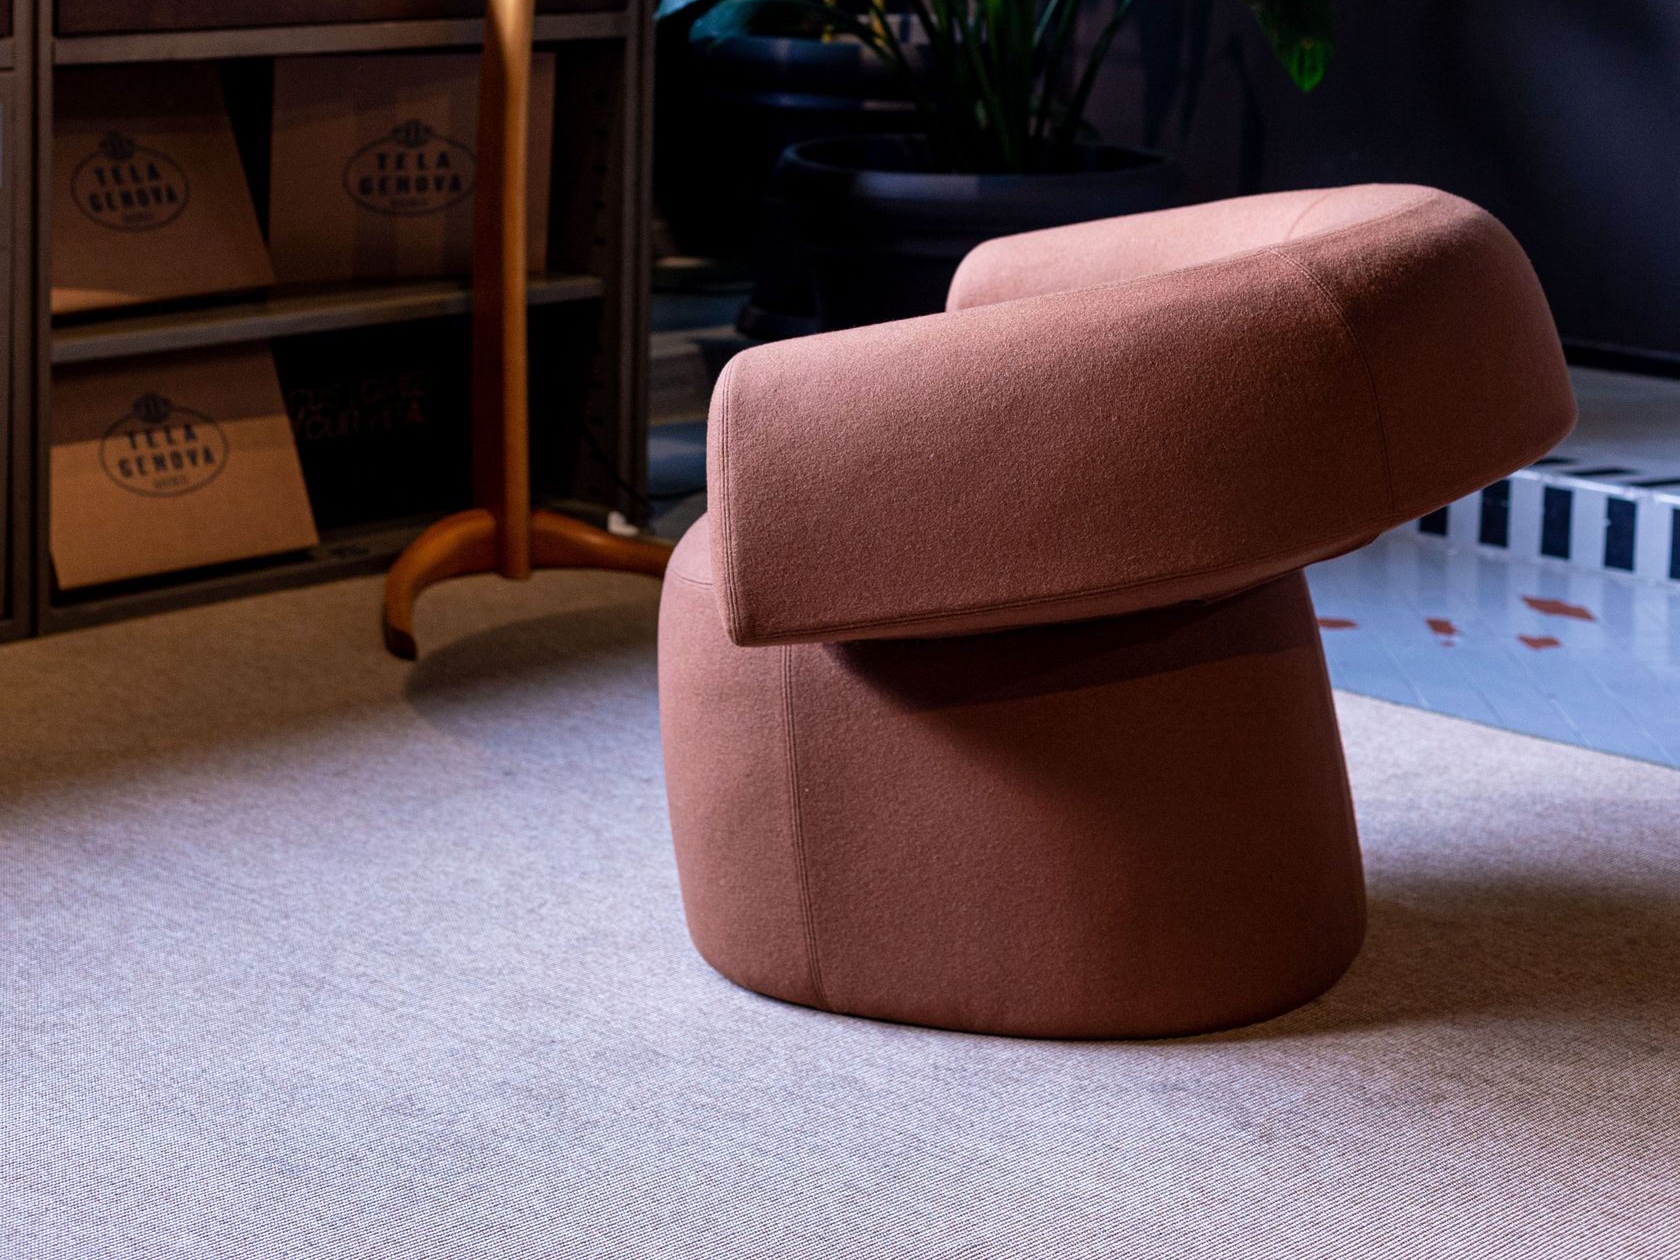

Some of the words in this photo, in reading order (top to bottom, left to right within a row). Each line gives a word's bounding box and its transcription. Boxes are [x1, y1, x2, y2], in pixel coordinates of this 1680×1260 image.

[377, 151, 449, 170] TELA
[94, 163, 161, 186] TELA
[358, 173, 461, 196] GENOVA
[89, 183, 176, 212] GENOVA
[128, 422, 197, 450] TELA
[118, 447, 214, 478] GENOVA
